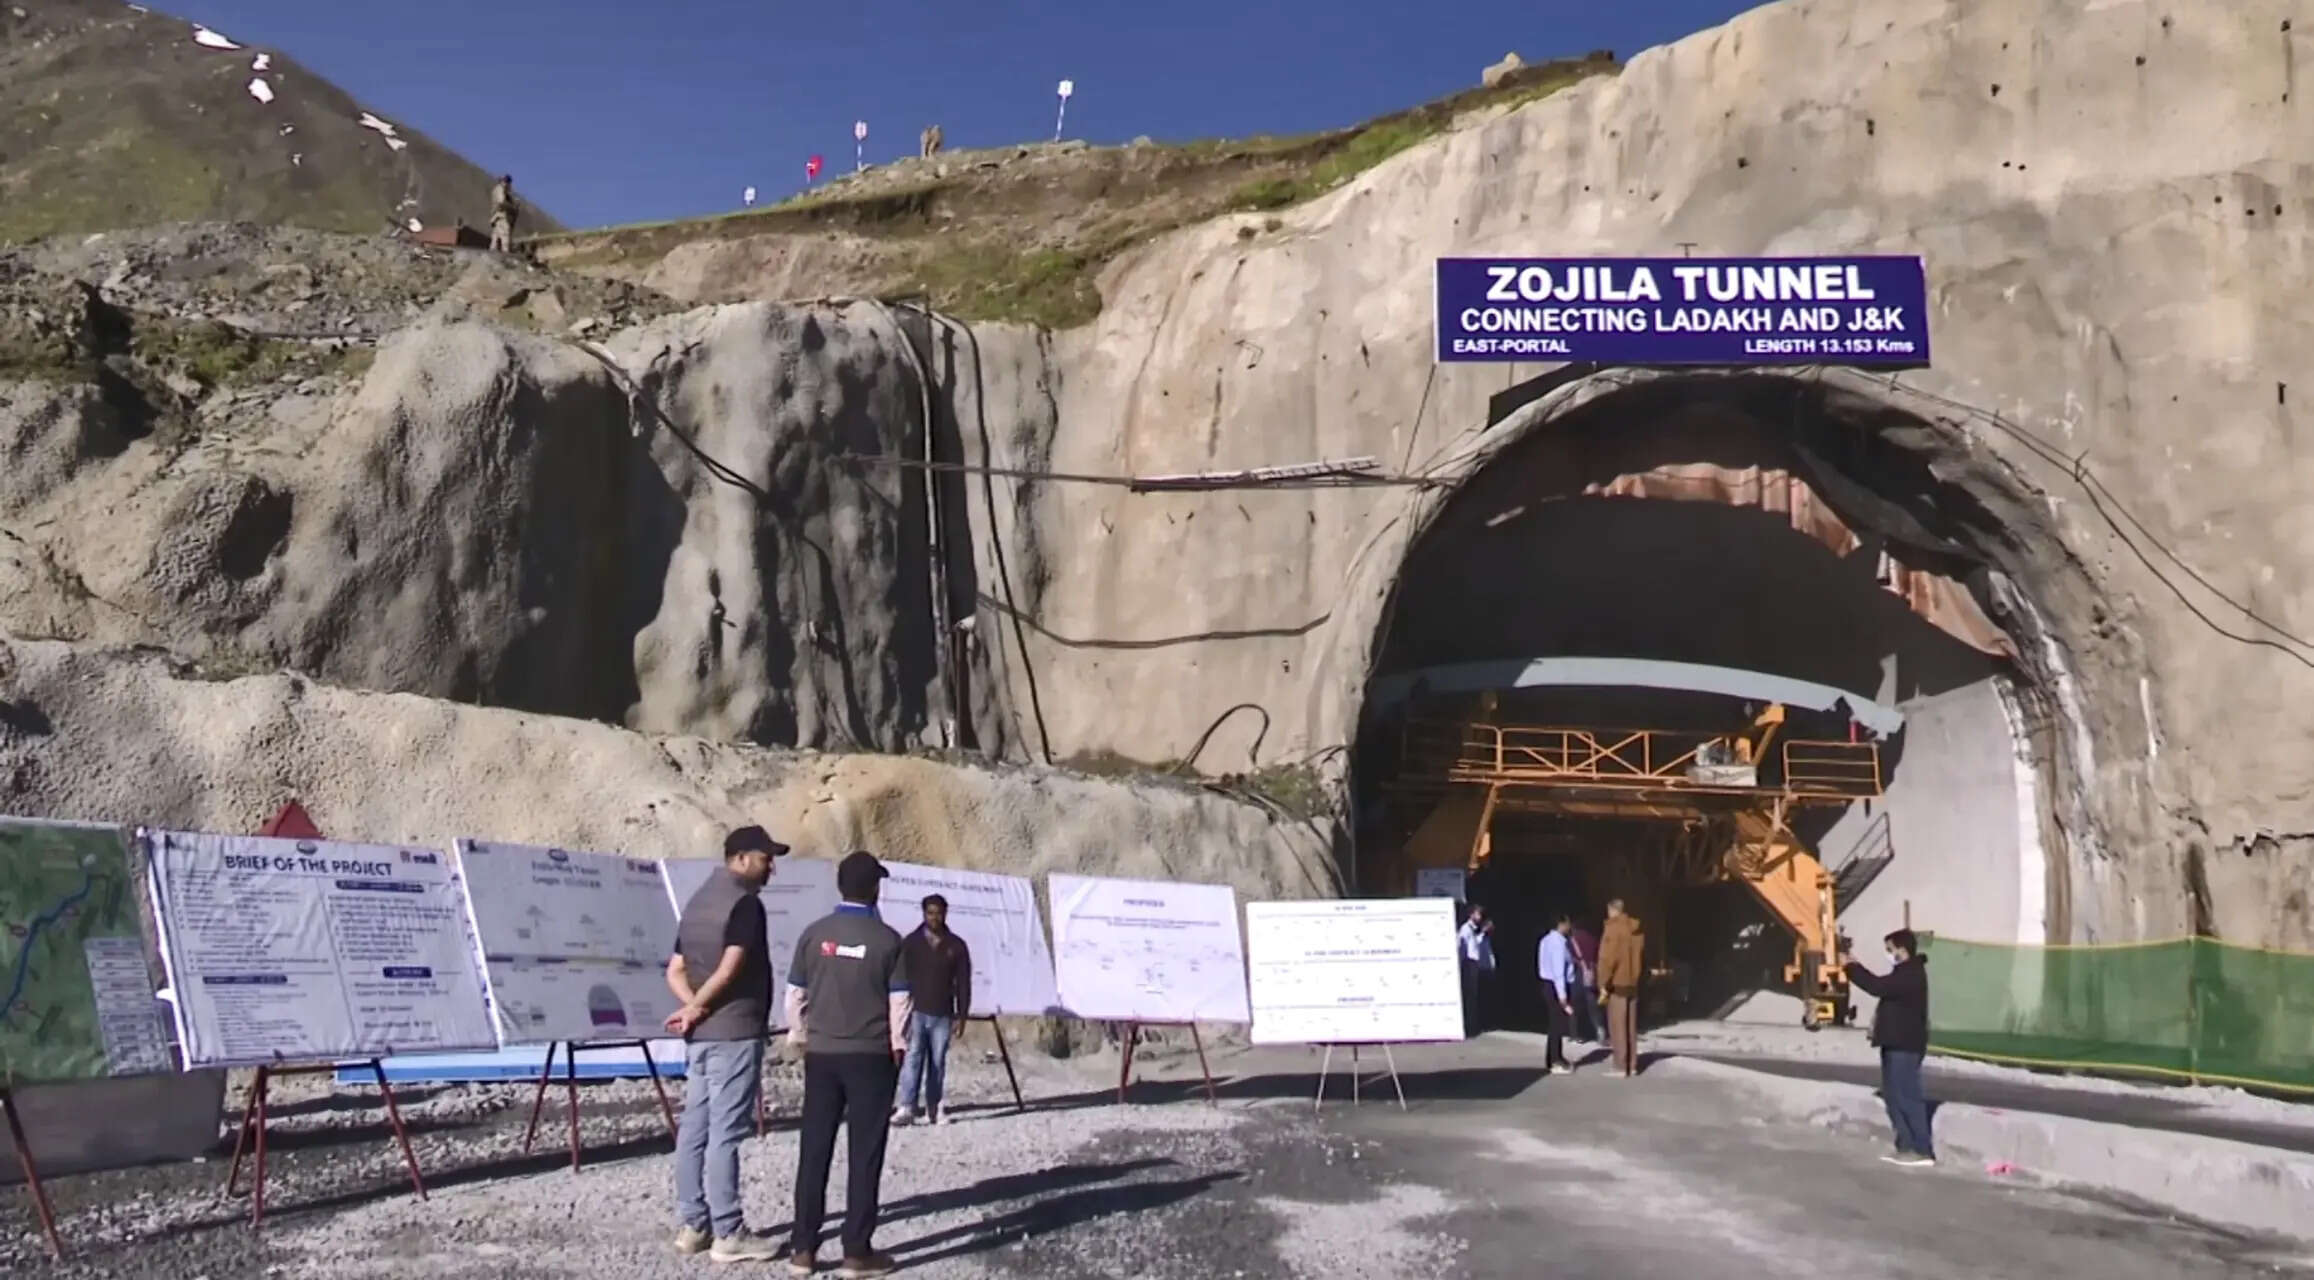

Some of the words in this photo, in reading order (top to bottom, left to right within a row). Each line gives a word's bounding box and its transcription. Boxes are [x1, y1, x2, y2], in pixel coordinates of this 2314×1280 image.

[1486, 266, 1661, 301] ZOJILA
[1673, 265, 1875, 301] TUNNEL
[1461, 308, 1647, 332] CONNECTING
[1655, 308, 1772, 332] LADAKH
[1778, 308, 1840, 332] AND
[1847, 307, 1905, 331] J&K
[1453, 338, 1571, 353] EAST-PORTAL
[1745, 339, 1816, 353] LENGTH
[1819, 338, 1873, 353] 13.153
[1876, 339, 1915, 353] Kms
[225, 855, 268, 871] BRIEF
[274, 857, 295, 872] OF
[299, 858, 328, 874] THE
[332, 860, 393, 876] PROJECT
